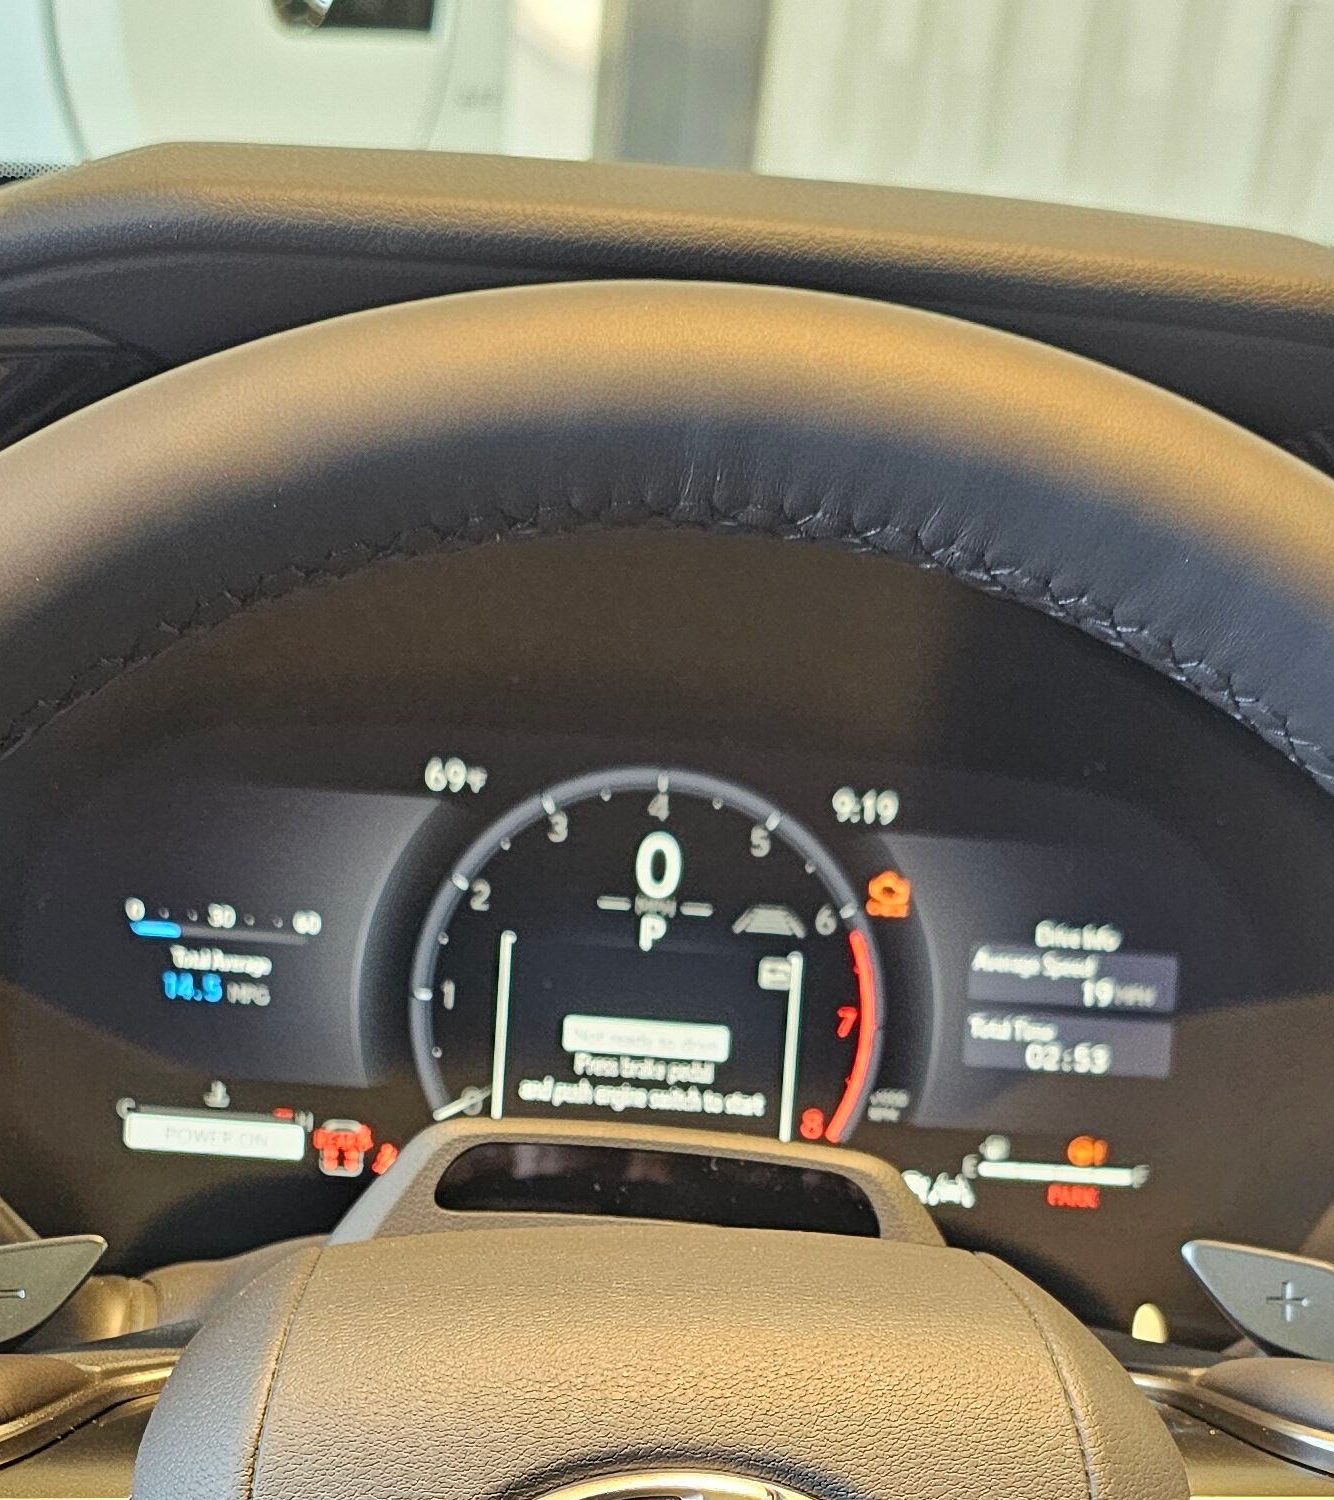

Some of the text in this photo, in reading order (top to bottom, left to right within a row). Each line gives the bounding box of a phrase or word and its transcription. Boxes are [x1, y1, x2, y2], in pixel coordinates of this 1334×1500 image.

[832, 786, 900, 826] 9:19
[548, 810, 568, 842] 3
[750, 825, 771, 858] 5
[635, 831, 683, 899] 0
[470, 879, 492, 911] 2
[639, 913, 667, 952] P
[815, 906, 838, 936] 6
[444, 979, 456, 1010] 1
[837, 1006, 858, 1038] 7
[800, 1108, 825, 1140] 8
